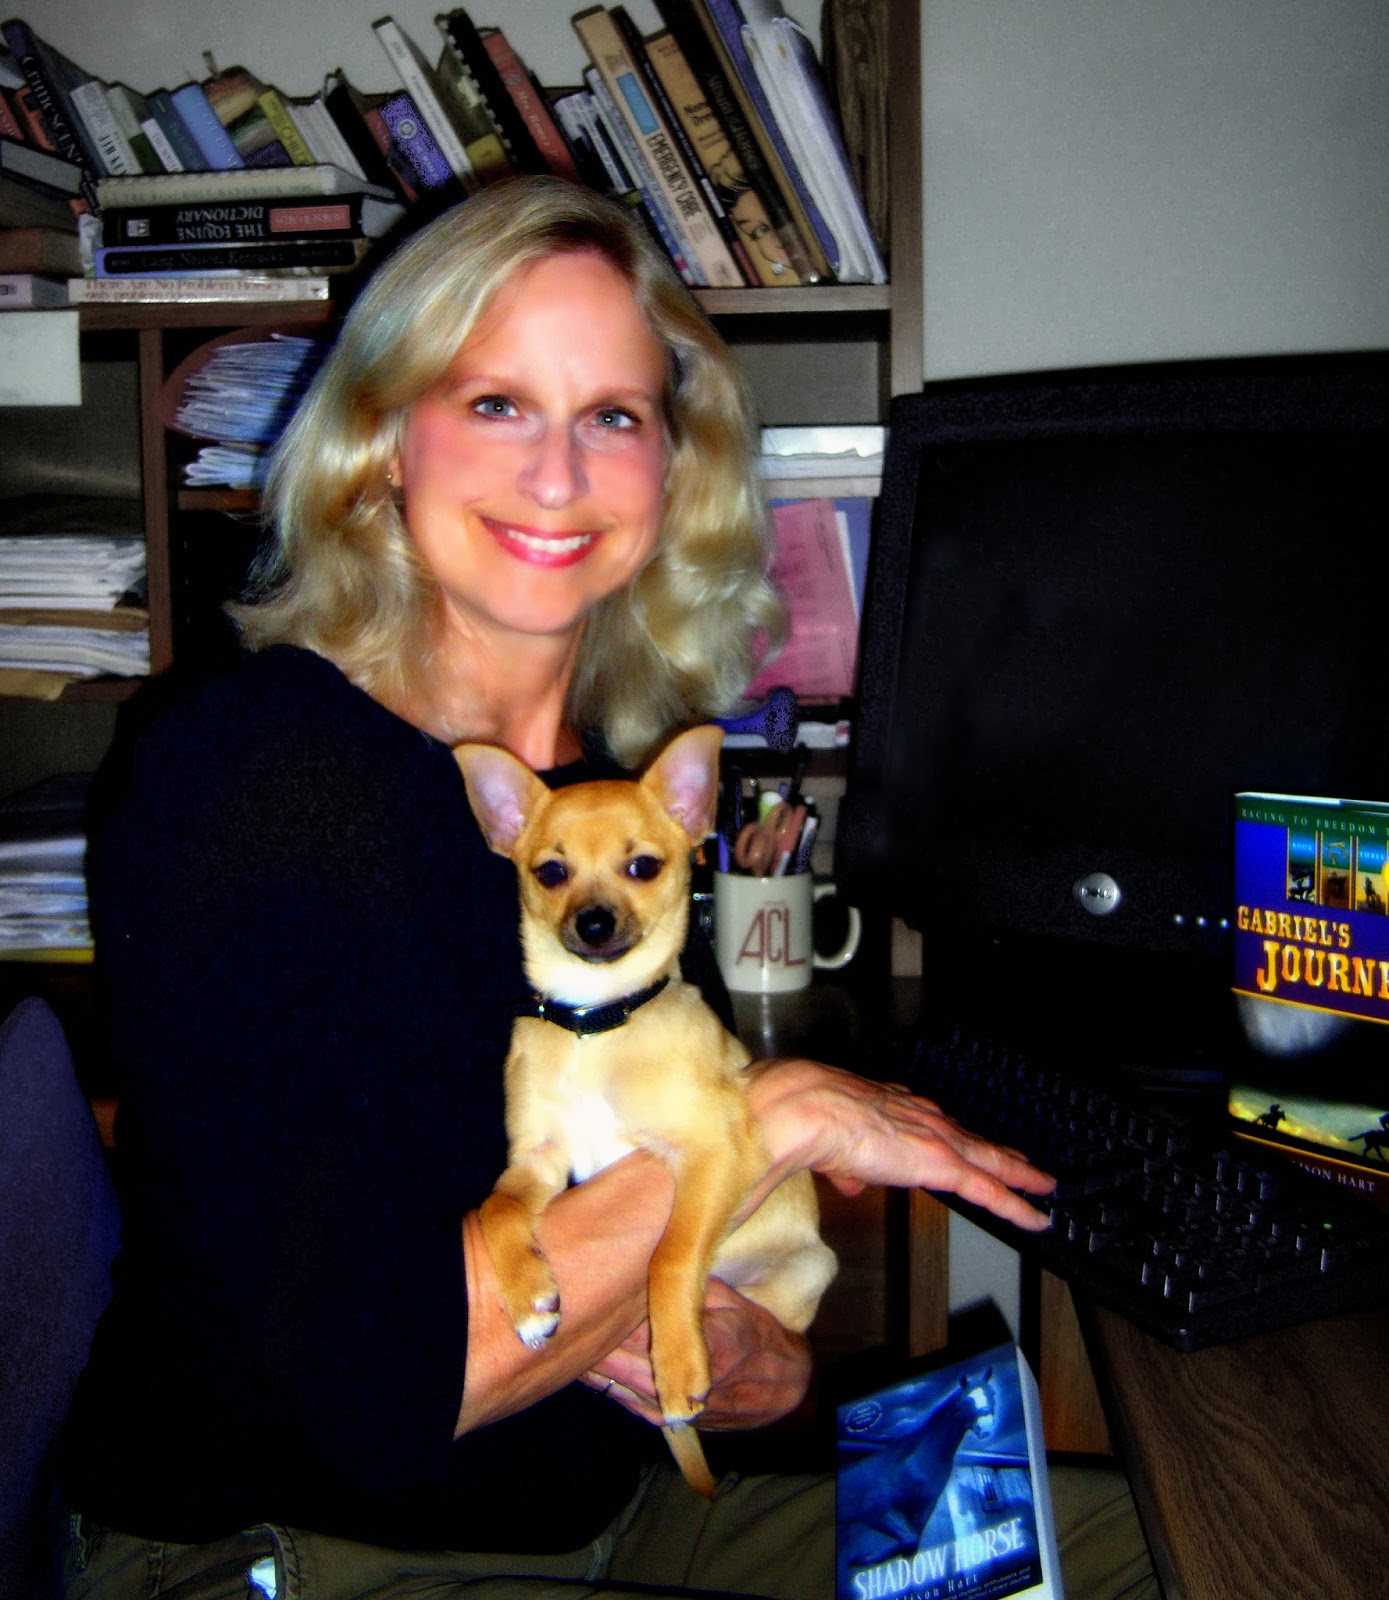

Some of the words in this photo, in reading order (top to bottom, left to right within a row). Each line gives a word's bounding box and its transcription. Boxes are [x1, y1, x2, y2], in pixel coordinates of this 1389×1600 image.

[646, 132, 690, 193] EMERGENCY
[675, 190, 701, 221] CARE
[176, 205, 264, 223] DICTIONARY
[176, 222, 232, 241] EQUINE
[235, 222, 265, 238] THE
[1241, 808, 1285, 823] RACING
[1293, 815, 1308, 826] TO
[1316, 818, 1376, 835] FREEDOM
[735, 906, 806, 968] ACL
[1237, 904, 1351, 949] GABRIEL'S
[1337, 1173, 1376, 1192] HART
[854, 1545, 948, 1600] SHADOW
[951, 1516, 1025, 1573] HORSE
[948, 1574, 977, 1592] Hart
